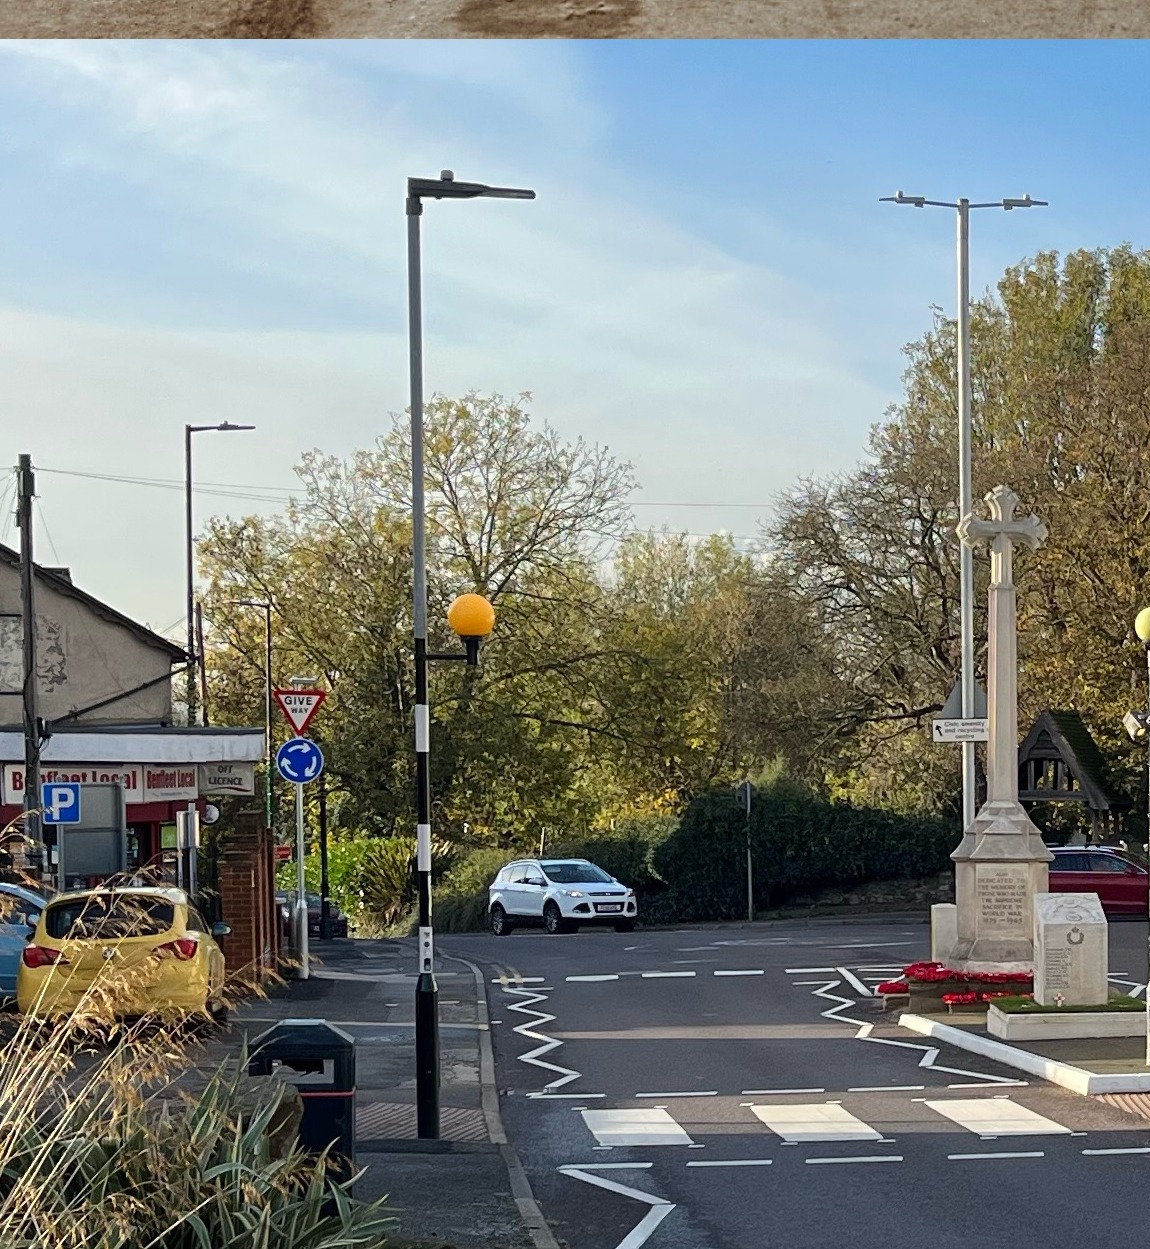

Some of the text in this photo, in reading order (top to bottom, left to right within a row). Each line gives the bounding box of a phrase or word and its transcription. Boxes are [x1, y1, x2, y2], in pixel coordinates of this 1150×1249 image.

[284, 695, 313, 706] GIVE
[147, 768, 195, 789] Benfleet Local
[208, 776, 243, 786] LICENCE
[51, 787, 75, 820] P
